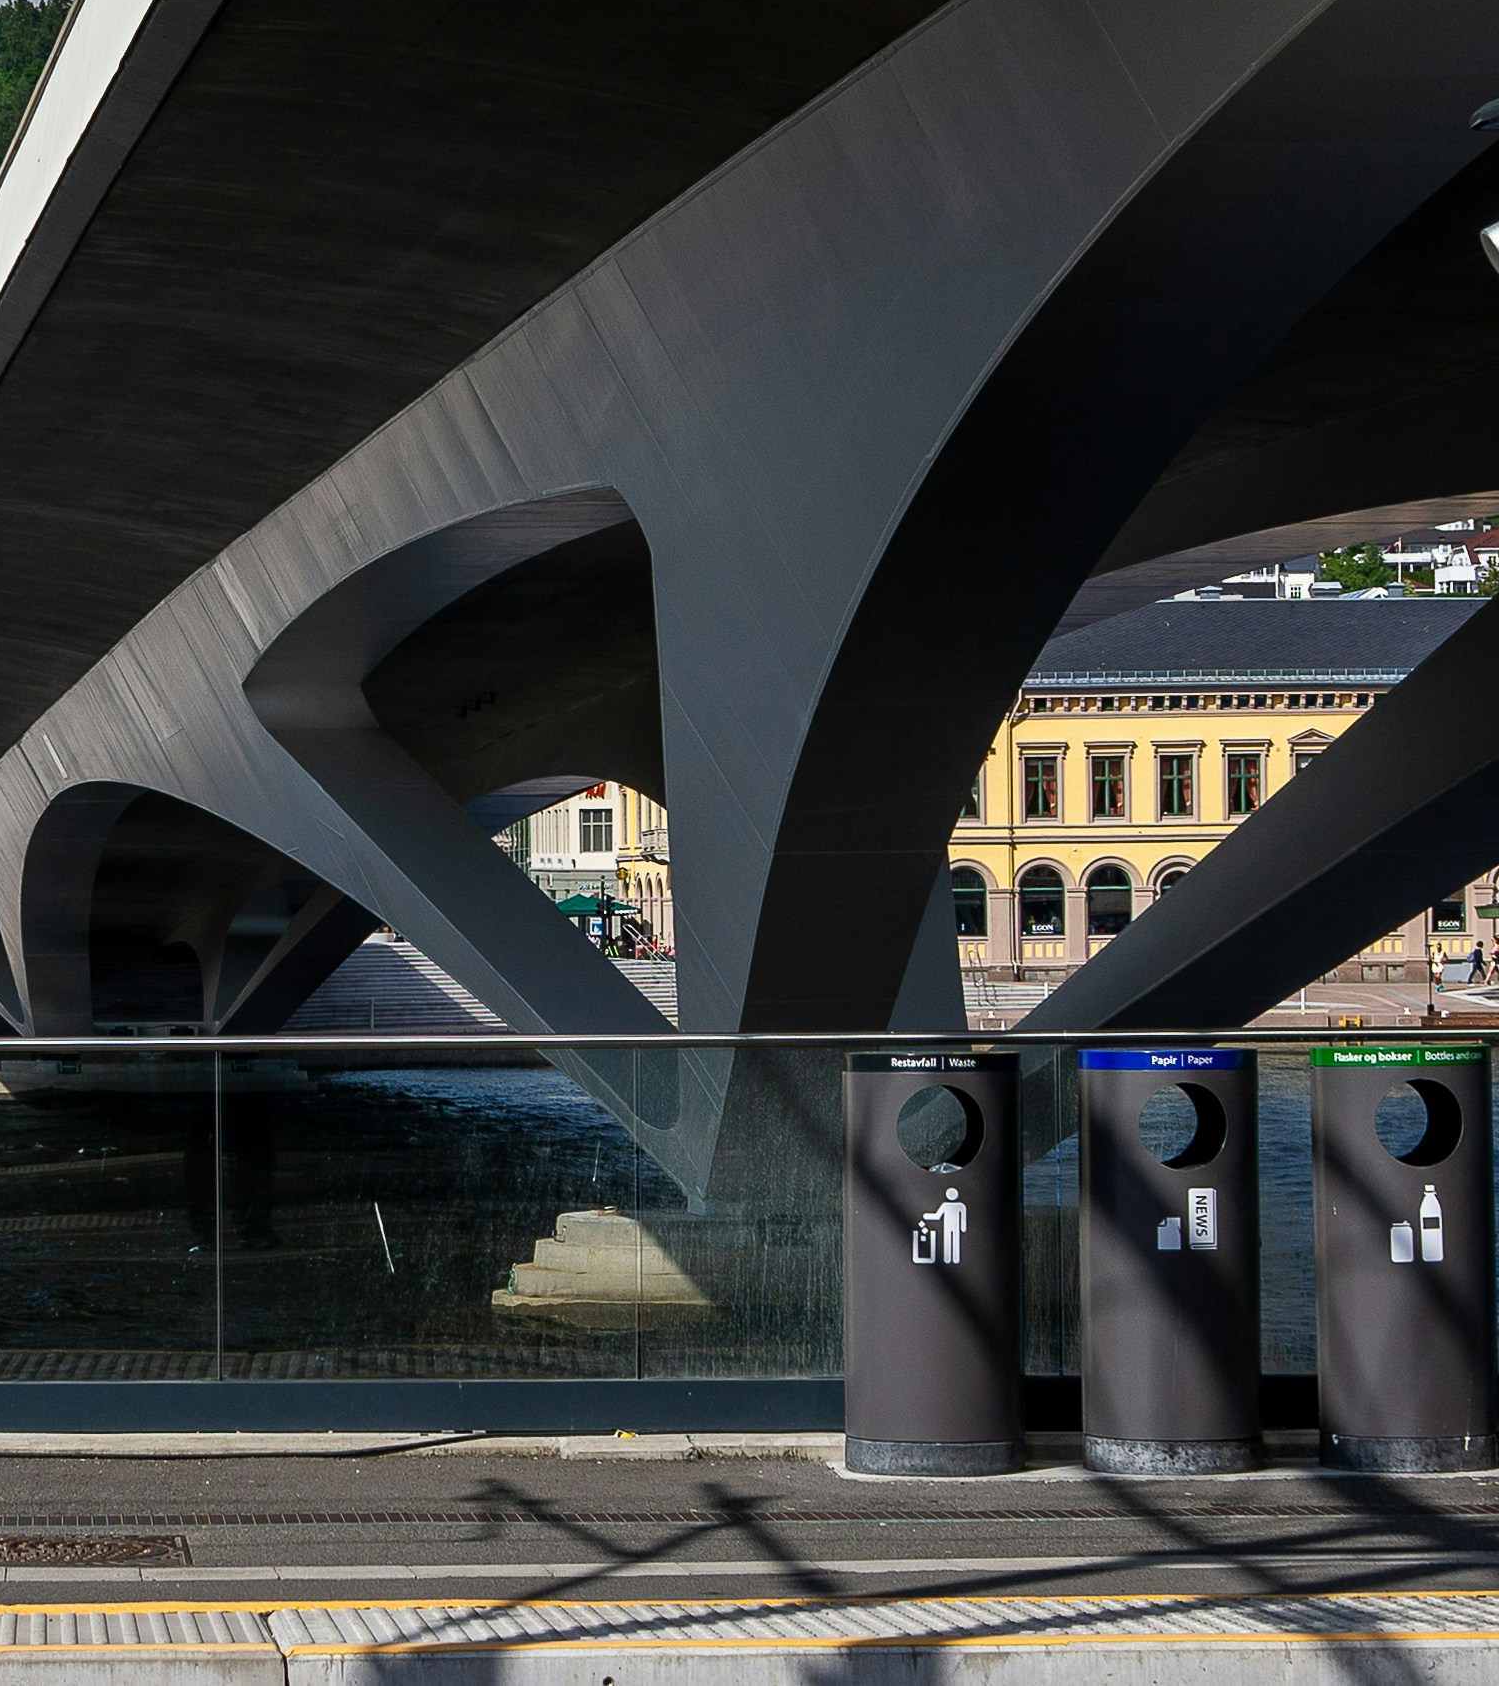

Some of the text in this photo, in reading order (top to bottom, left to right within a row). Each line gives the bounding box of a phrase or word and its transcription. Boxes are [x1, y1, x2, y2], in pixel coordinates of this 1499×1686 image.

[891, 1057, 976, 1068] Restavfall Waste
[1151, 1055, 1213, 1067] Papir Paper
[1333, 1052, 1363, 1062] Flasker
[1363, 1053, 1377, 1064] og
[1378, 1051, 1412, 1062] bokser
[1424, 1051, 1455, 1061] Bottles
[1455, 1051, 1470, 1060] and
[1195, 1195, 1208, 1237] NEWS
